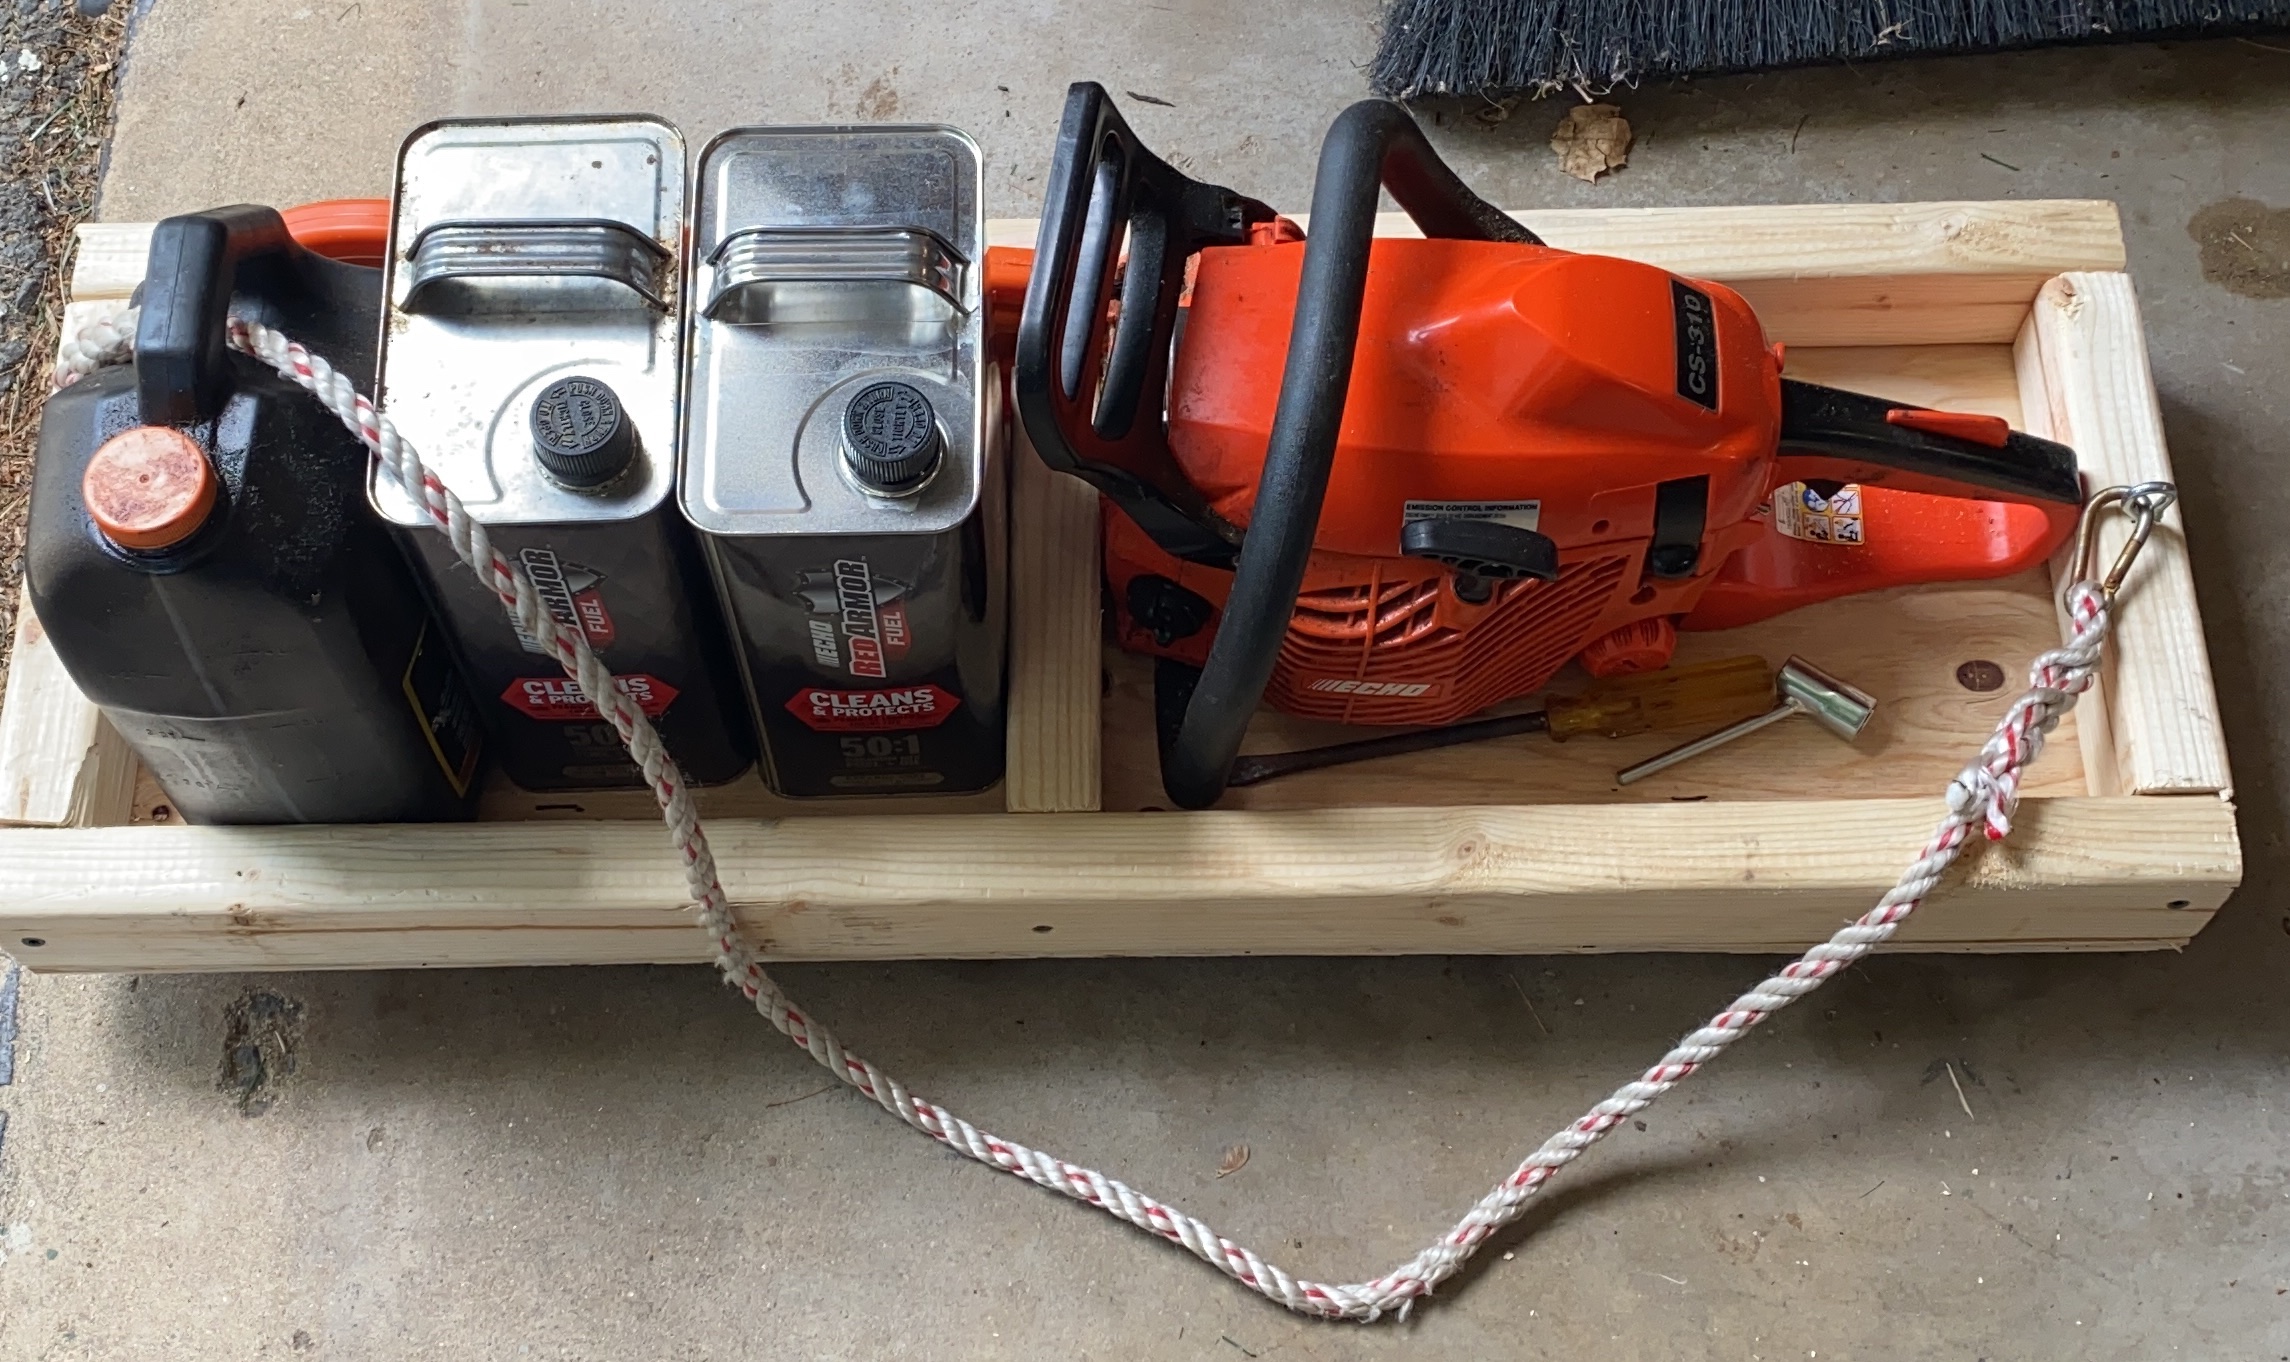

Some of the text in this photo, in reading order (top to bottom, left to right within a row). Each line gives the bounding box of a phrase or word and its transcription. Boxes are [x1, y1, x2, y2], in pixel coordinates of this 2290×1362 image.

[1684, 294, 1707, 395] CS-310
[579, 400, 596, 428] CLOSE
[871, 406, 886, 436] CLOSE
[1406, 503, 1539, 512] EMISSION CONTROL INFORMATION
[580, 599, 609, 634] FUEL
[883, 611, 906, 646] FUEL
[529, 694, 545, 705] &
[809, 689, 934, 708] CLEANS
[1316, 679, 1431, 697] ECHO
[812, 702, 936, 717] & PROTECTS
[840, 734, 920, 757] 50:1
